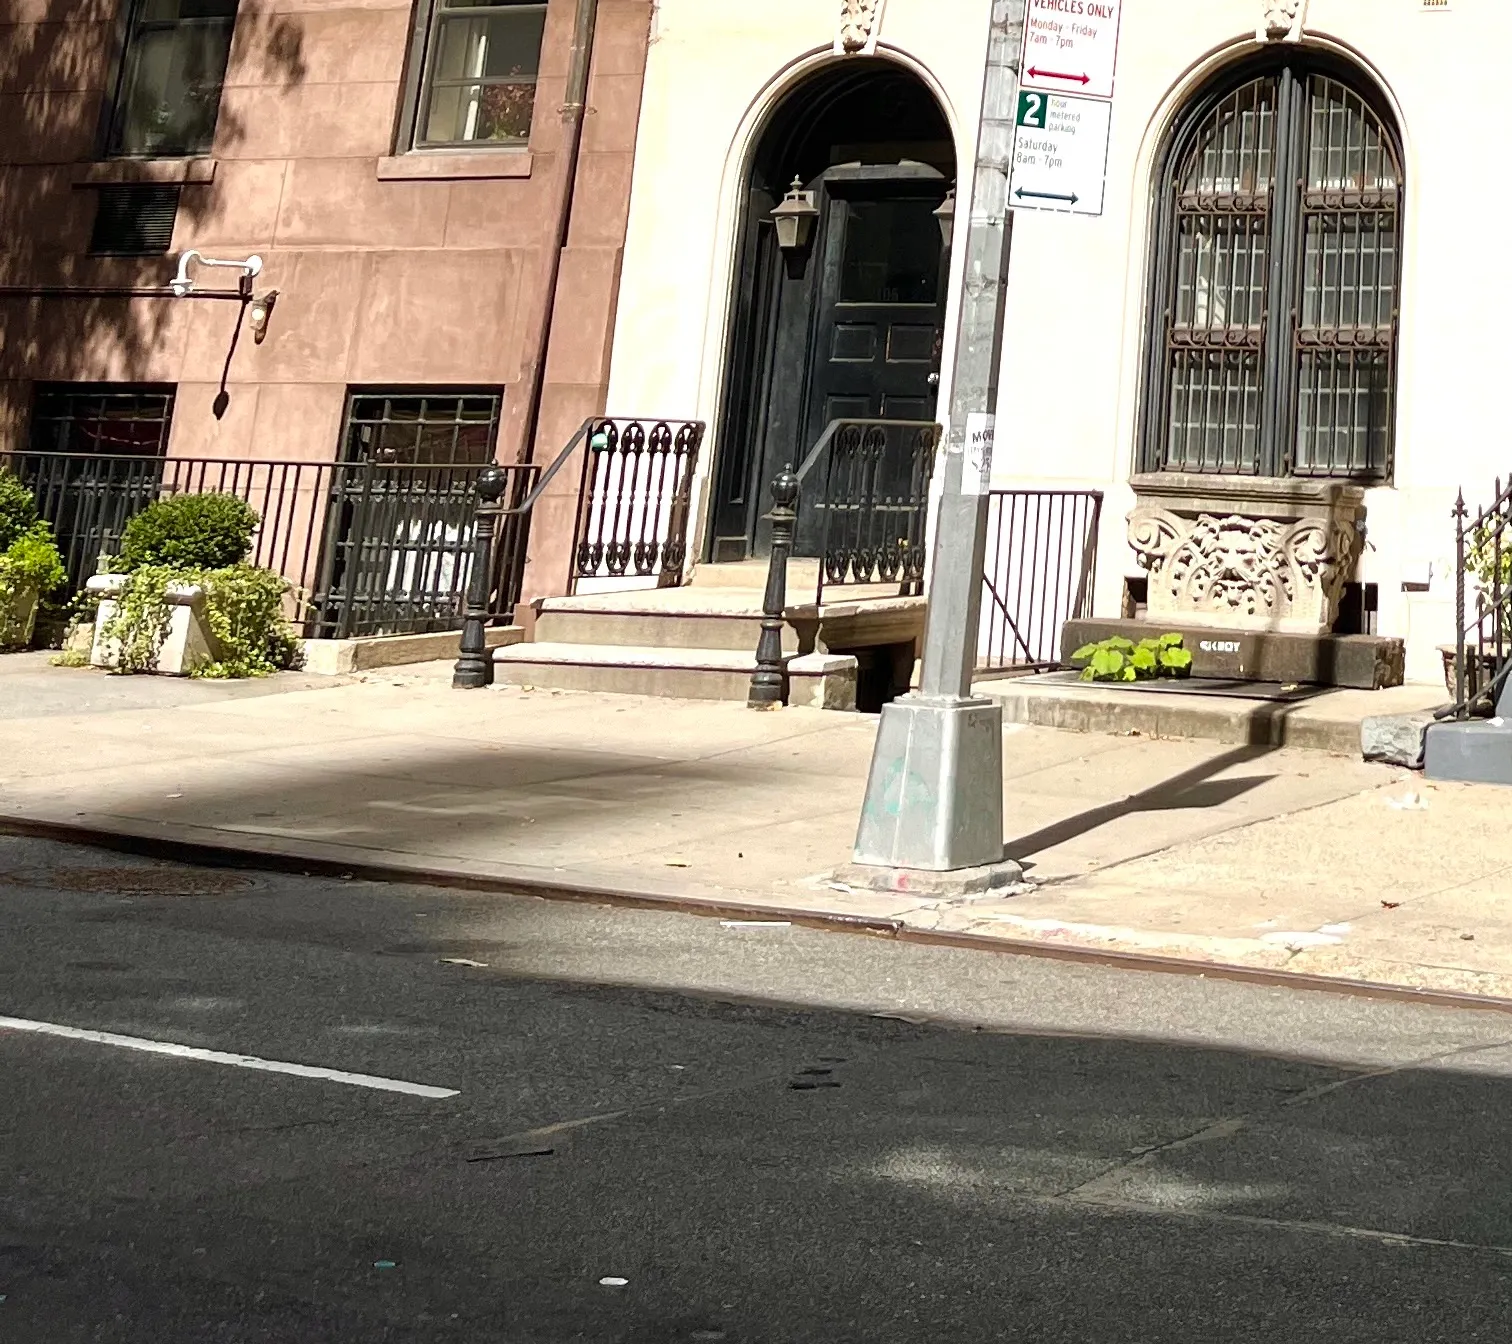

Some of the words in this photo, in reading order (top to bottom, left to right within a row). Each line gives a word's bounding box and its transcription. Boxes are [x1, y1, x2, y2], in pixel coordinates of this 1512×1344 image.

[1087, 2, 1114, 19] ONLY
[1030, 17, 1063, 35] Monday
[1071, 23, 1098, 39] Friday
[1029, 31, 1048, 45] 7am
[1056, 35, 1074, 49] 7pm
[1022, 93, 1041, 126] 2
[1049, 111, 1081, 122] metered
[1048, 123, 1076, 136] parking
[1018, 136, 1058, 154] Saturday
[1016, 151, 1036, 165] 8am
[1044, 154, 1063, 169] 7pm
